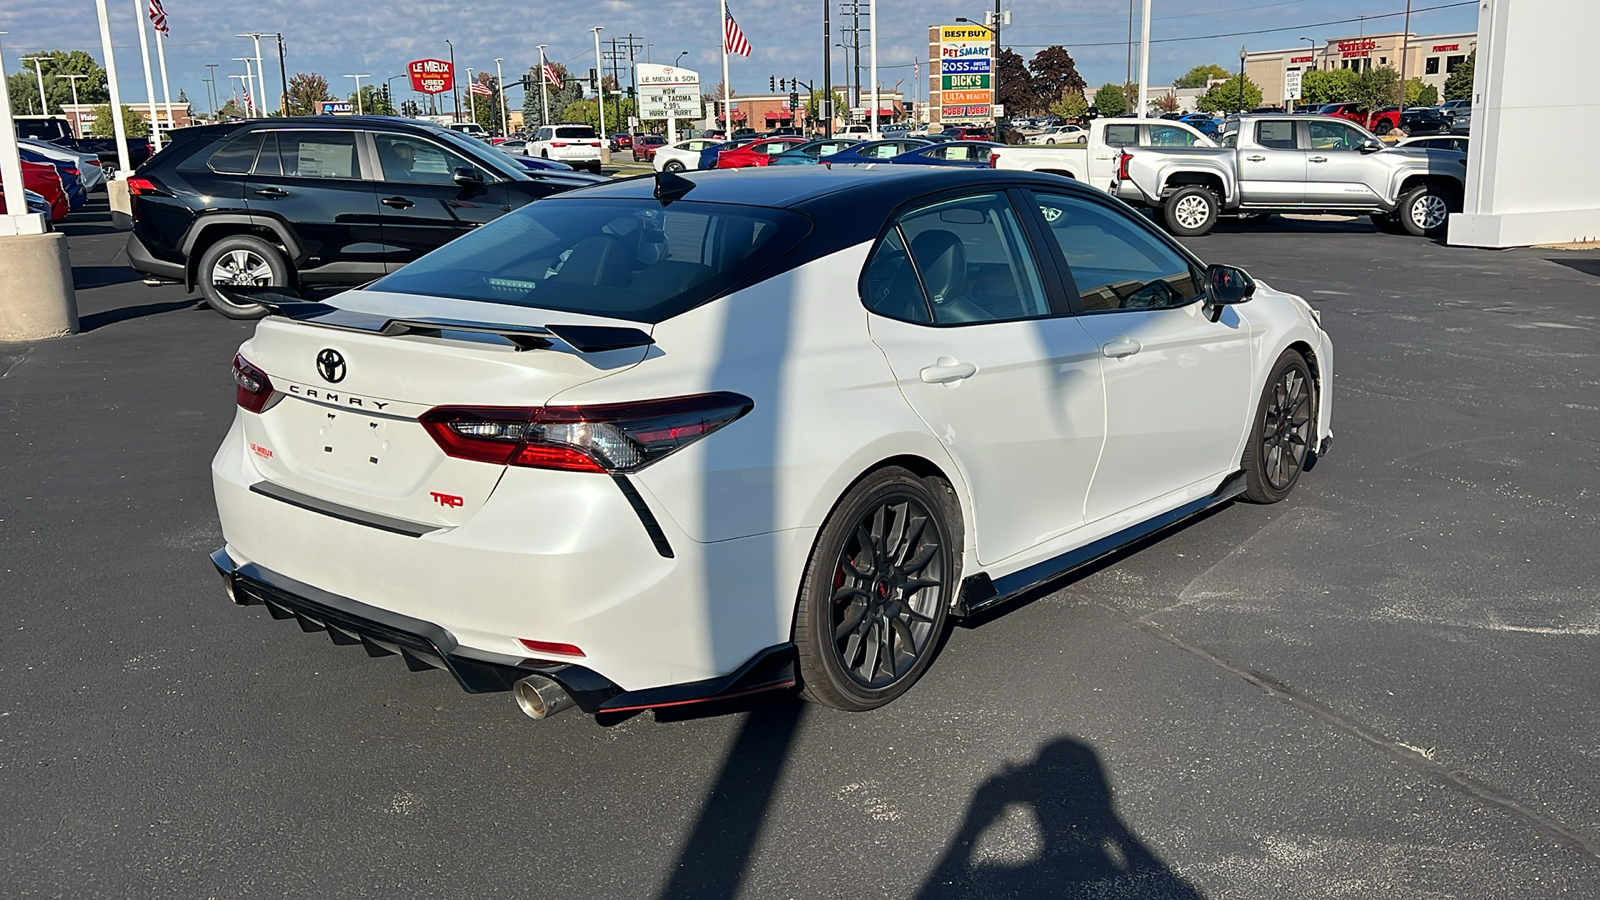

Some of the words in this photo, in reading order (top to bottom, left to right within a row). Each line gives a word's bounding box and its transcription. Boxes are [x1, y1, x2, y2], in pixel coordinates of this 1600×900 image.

[413, 63, 423, 72] LE
[424, 61, 449, 72] MIEUX
[942, 62, 970, 71] ROSS
[952, 75, 982, 86] DICK'S
[945, 92, 966, 101] ULTA
[289, 385, 390, 411] CAMRY
[250, 442, 257, 451] LE
[430, 491, 465, 508] TRD
